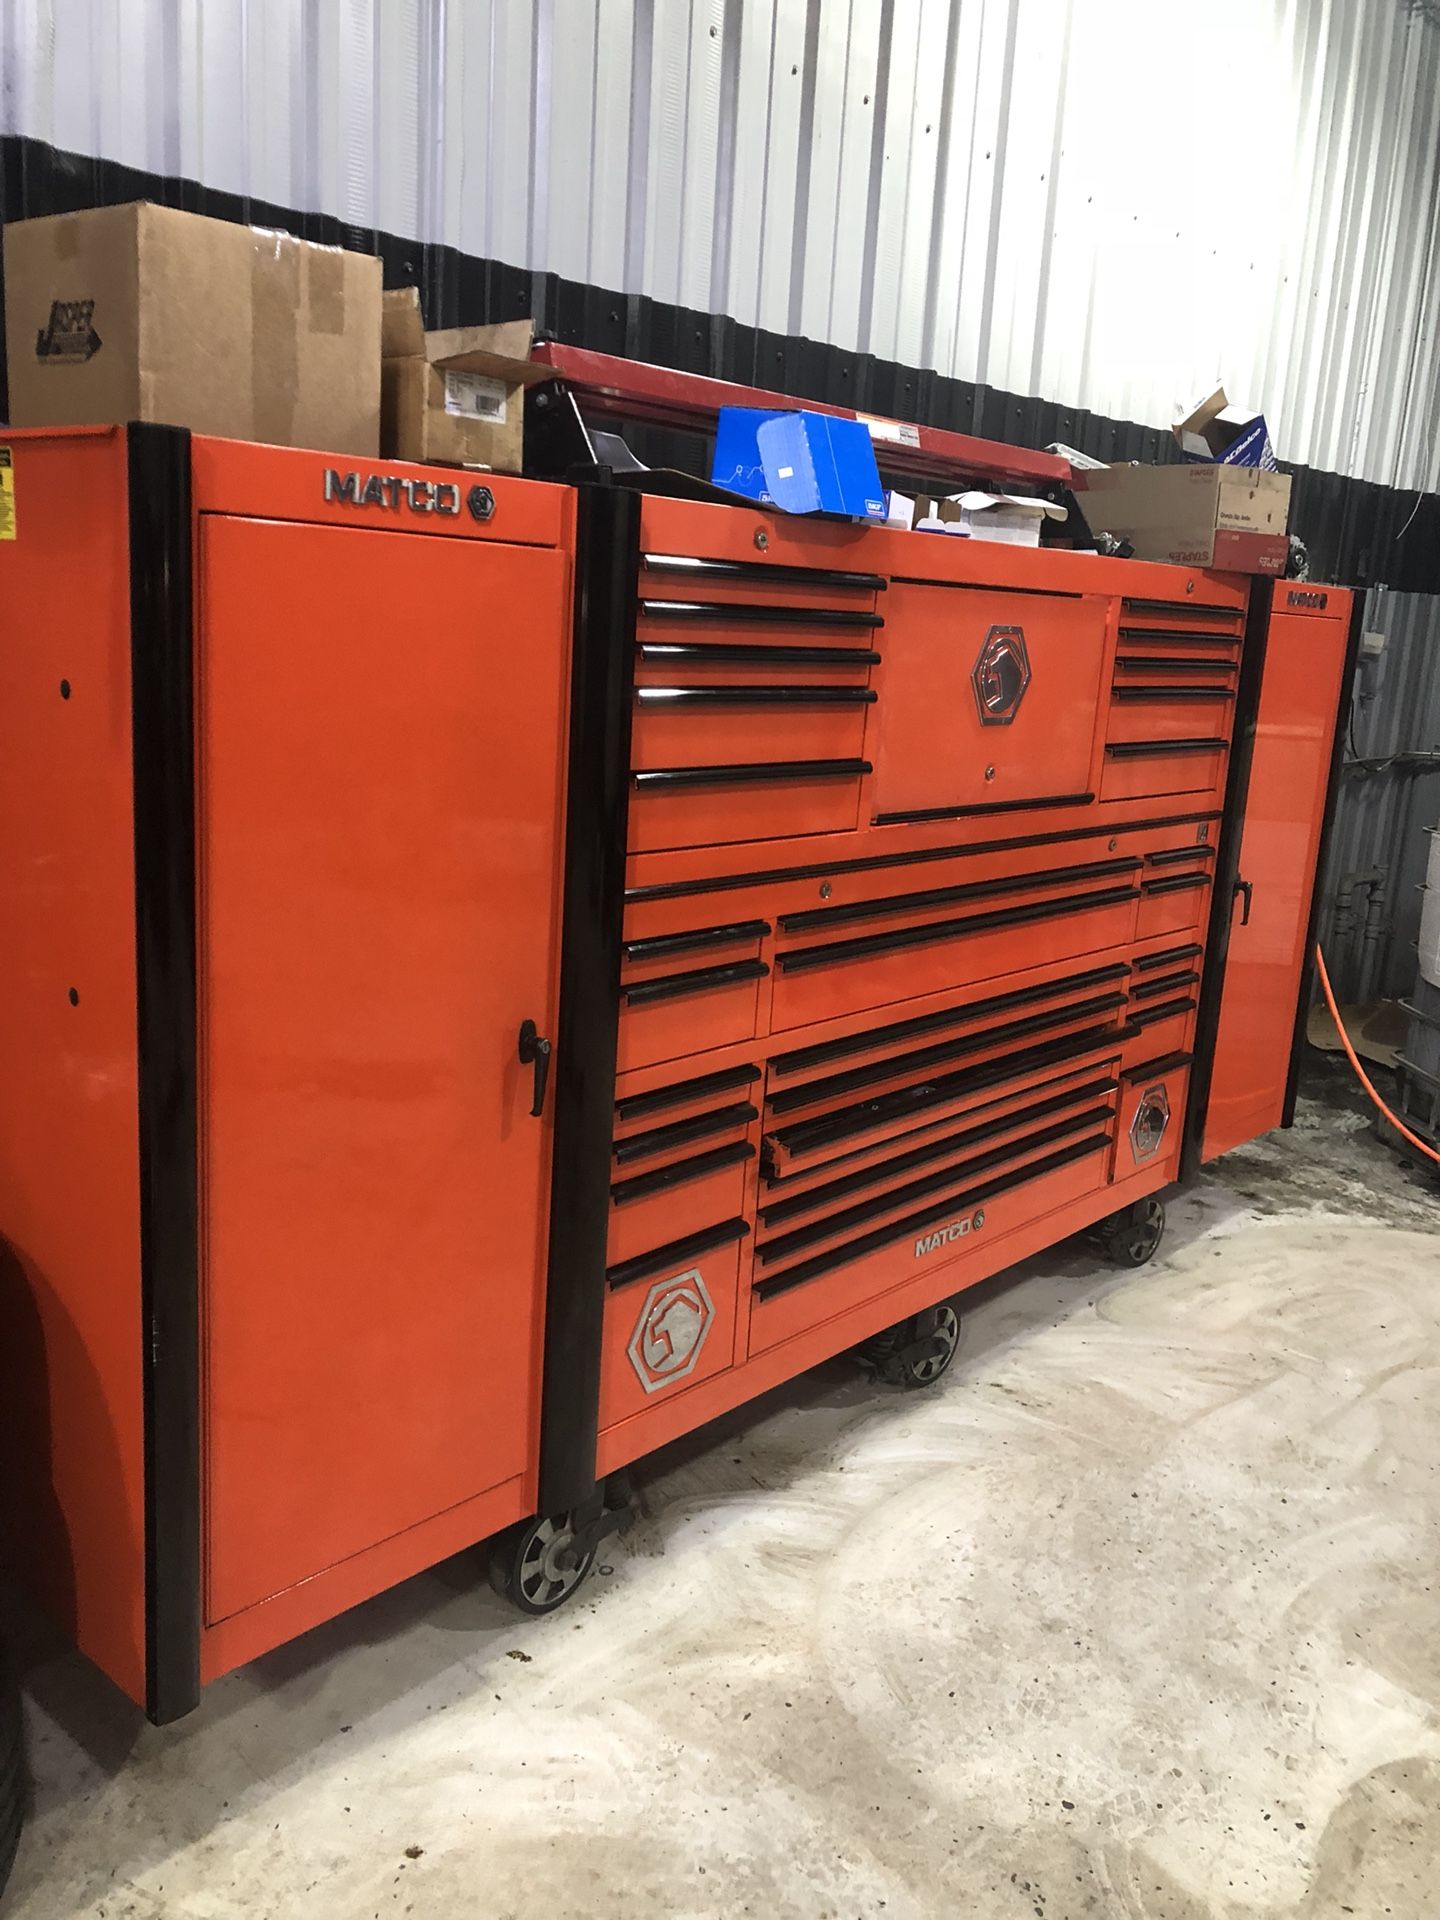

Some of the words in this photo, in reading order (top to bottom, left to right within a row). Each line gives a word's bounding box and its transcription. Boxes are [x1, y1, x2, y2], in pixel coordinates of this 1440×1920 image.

[324, 468, 460, 514] MATCO
[1168, 551, 1209, 561] STAPLES
[915, 1217, 971, 1257] MATCO
